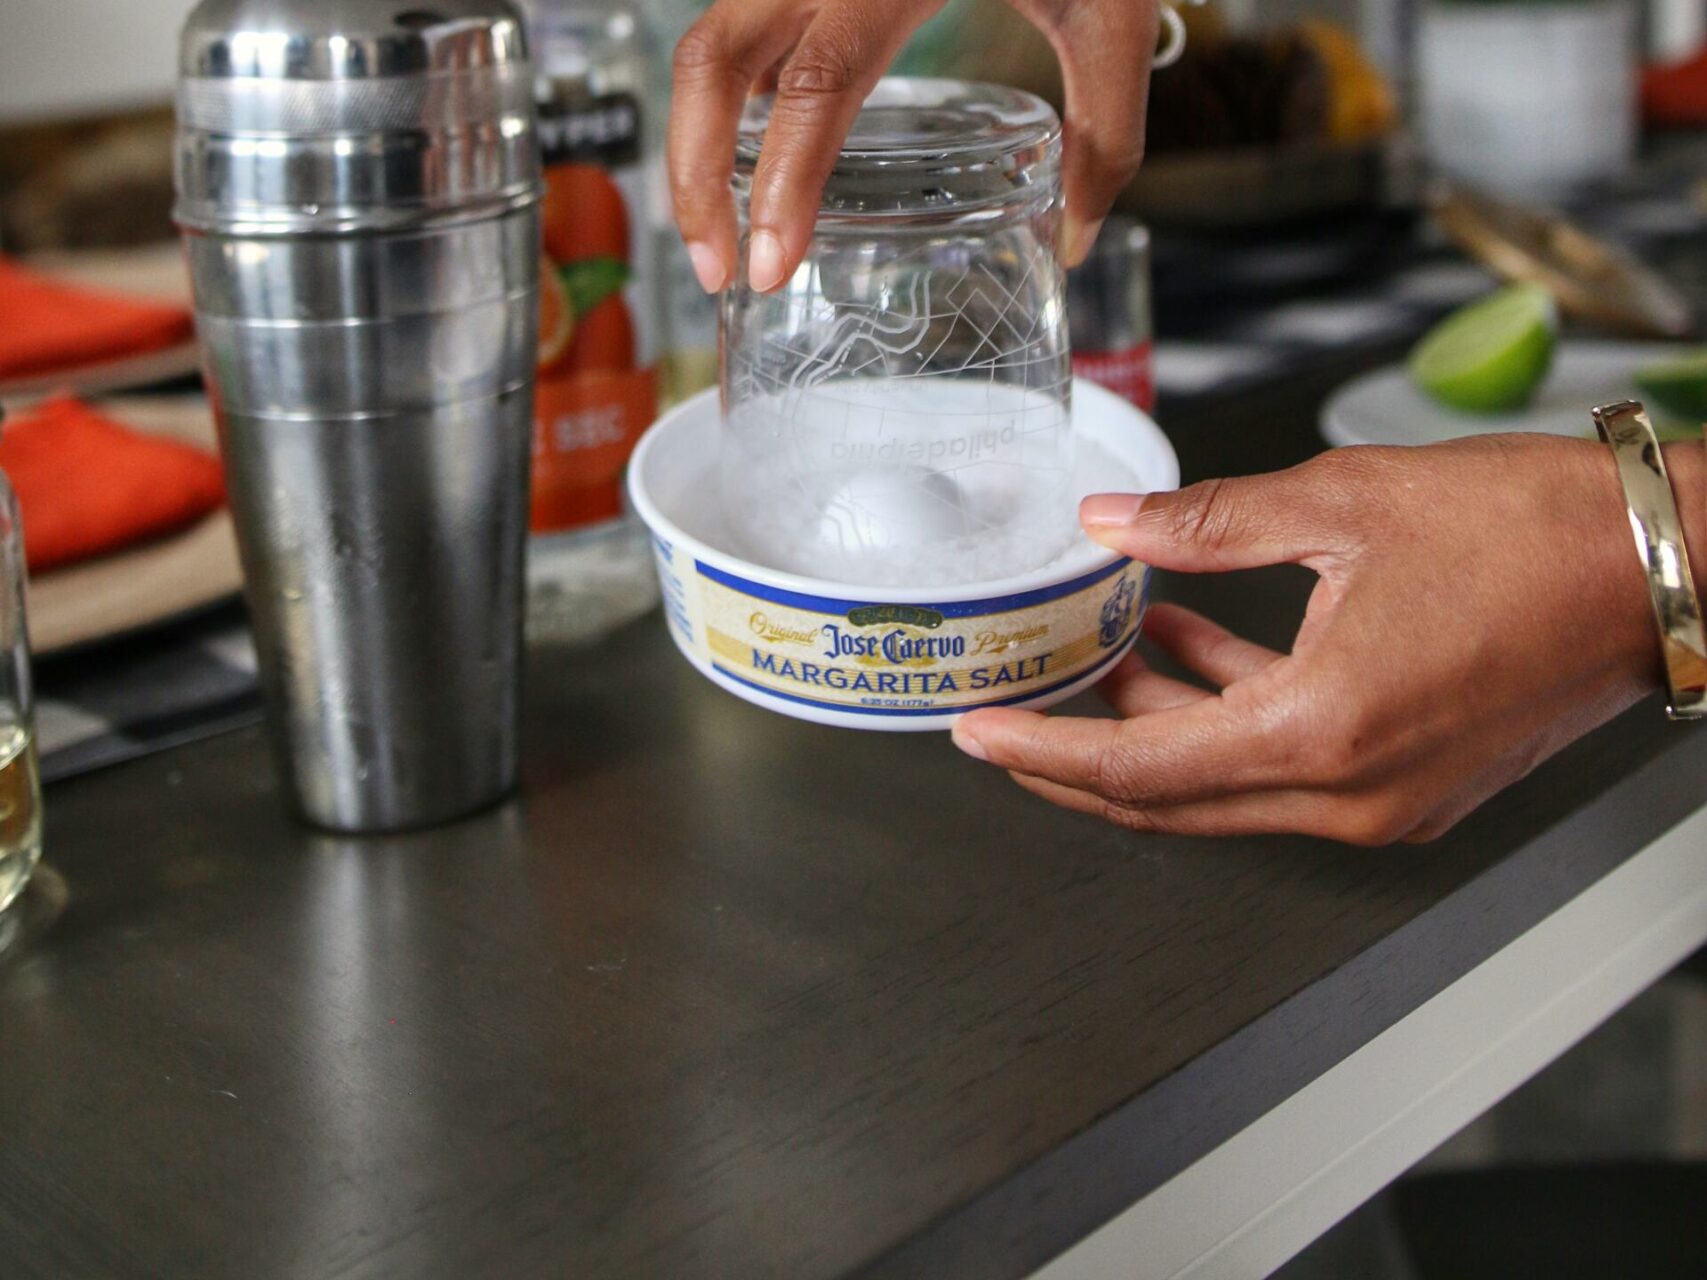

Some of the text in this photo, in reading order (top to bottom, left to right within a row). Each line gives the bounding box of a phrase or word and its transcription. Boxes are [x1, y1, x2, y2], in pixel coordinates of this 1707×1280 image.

[821, 624, 966, 665] Jose Cuervo
[752, 650, 1053, 693] MARGARITA SALT
